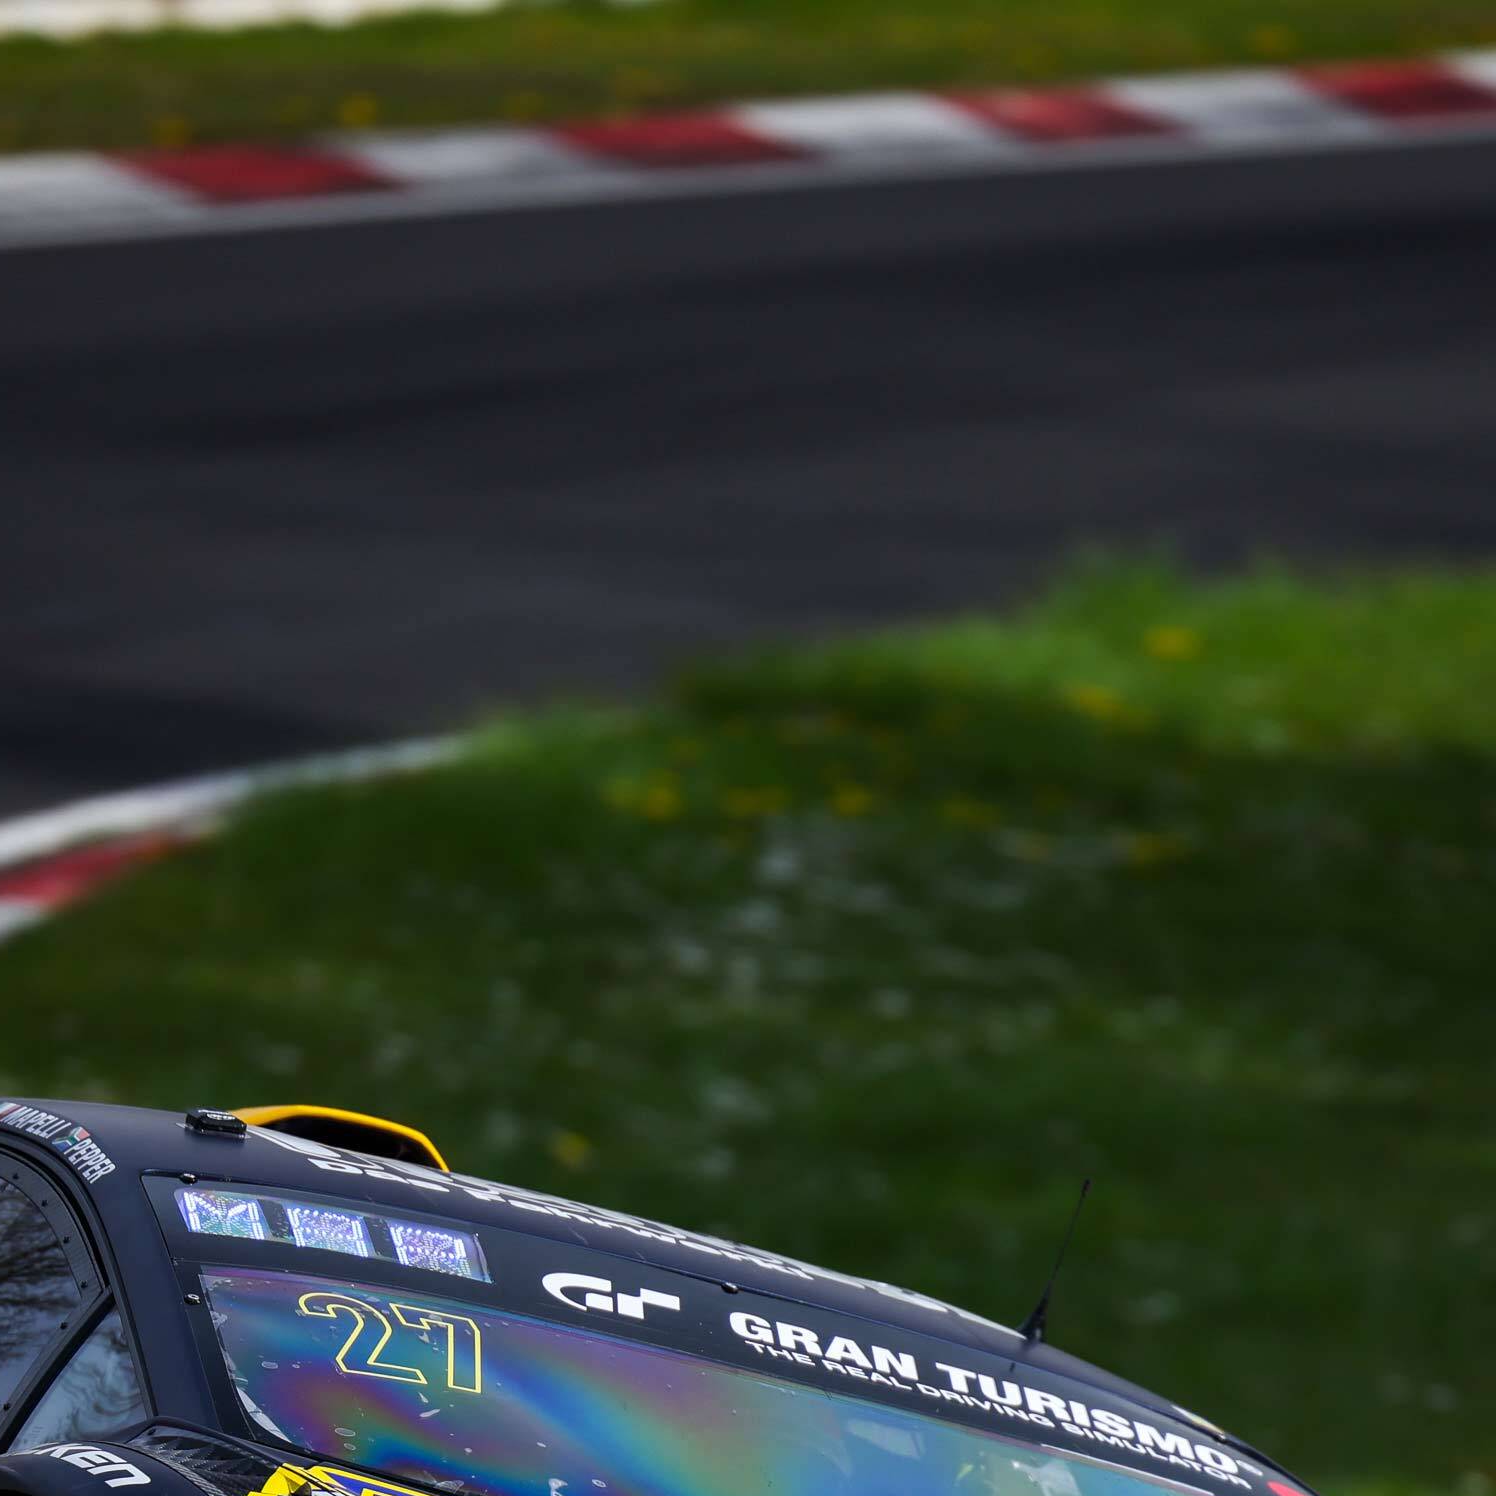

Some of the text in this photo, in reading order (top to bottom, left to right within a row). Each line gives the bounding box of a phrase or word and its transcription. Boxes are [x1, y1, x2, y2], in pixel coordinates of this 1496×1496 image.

[0, 1107, 73, 1139] MAPELLI
[64, 1138, 116, 1184] PEPPER
[298, 1292, 483, 1394] 27
[729, 1310, 1243, 1475] GRAN TURISMO
[745, 1340, 1252, 1489] THE REAL DRIVING SIMULATOR
